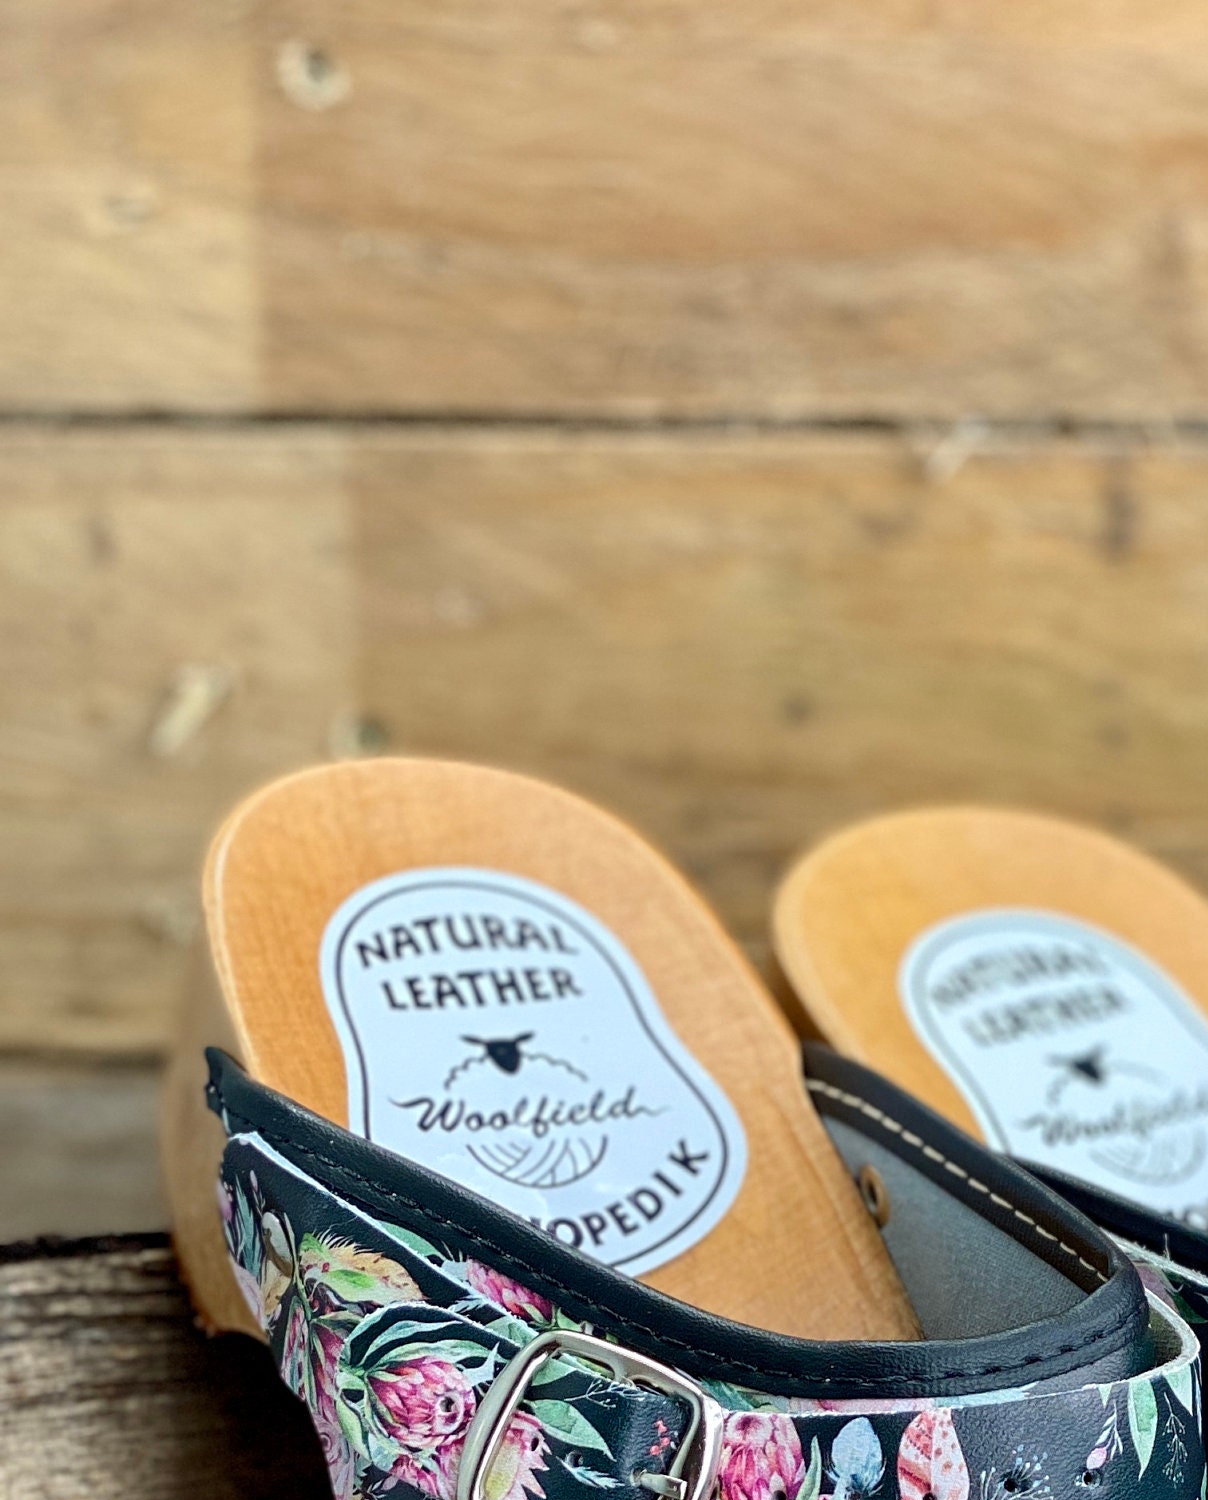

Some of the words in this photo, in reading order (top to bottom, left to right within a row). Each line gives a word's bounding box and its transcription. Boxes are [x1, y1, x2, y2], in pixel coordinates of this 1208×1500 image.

[355, 914, 579, 969] NATURAL
[381, 968, 583, 1012] LEATHER
[388, 1085, 668, 1139] Woolfield
[529, 1138, 711, 1248] OPEDIK
